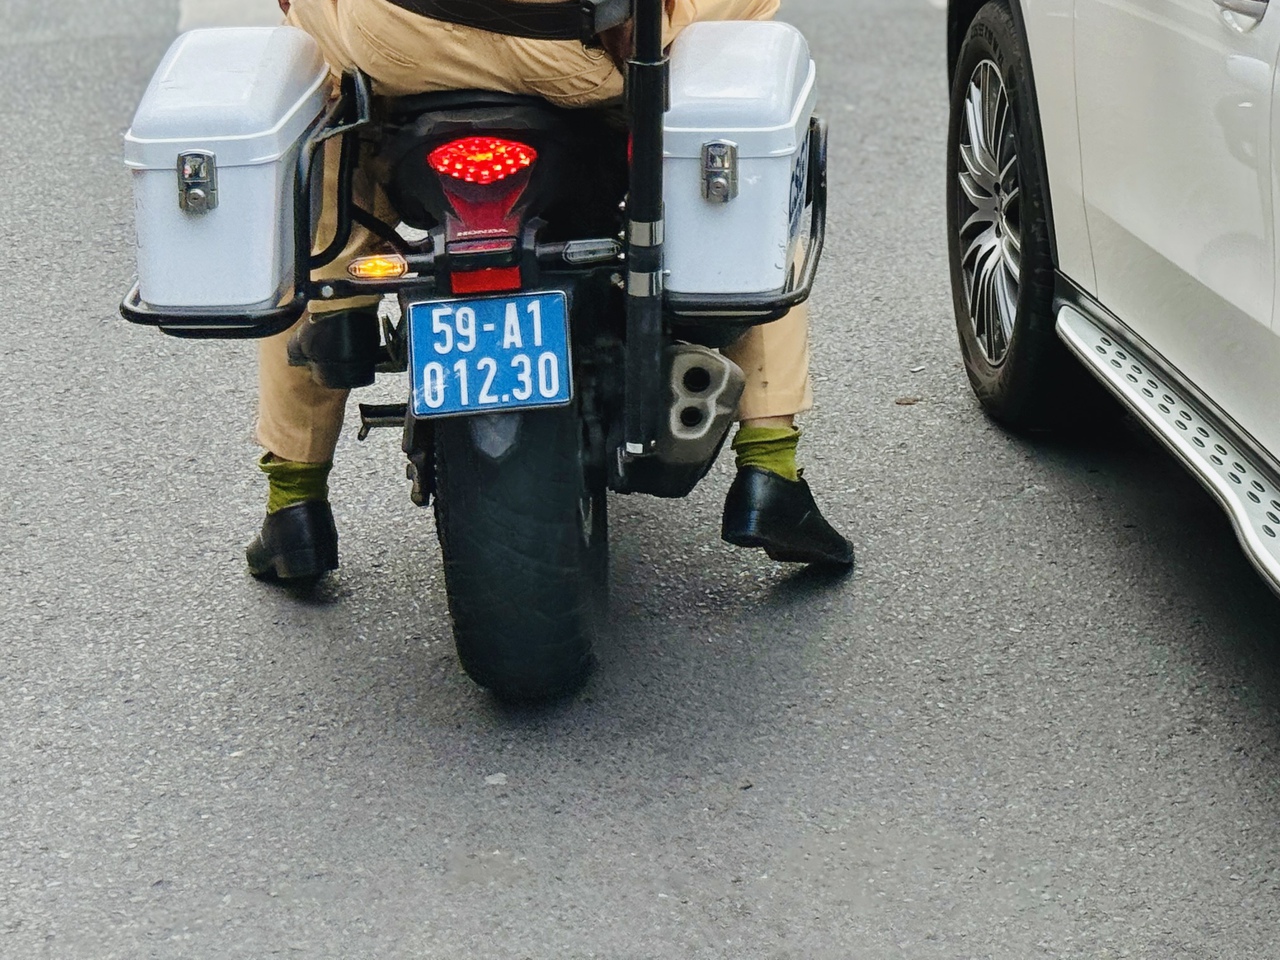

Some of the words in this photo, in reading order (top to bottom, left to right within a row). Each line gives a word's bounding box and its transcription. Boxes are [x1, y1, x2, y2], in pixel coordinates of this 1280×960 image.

[457, 228, 509, 237] HONDA
[431, 300, 543, 355] 59-A1
[423, 351, 559, 409] 012.30
